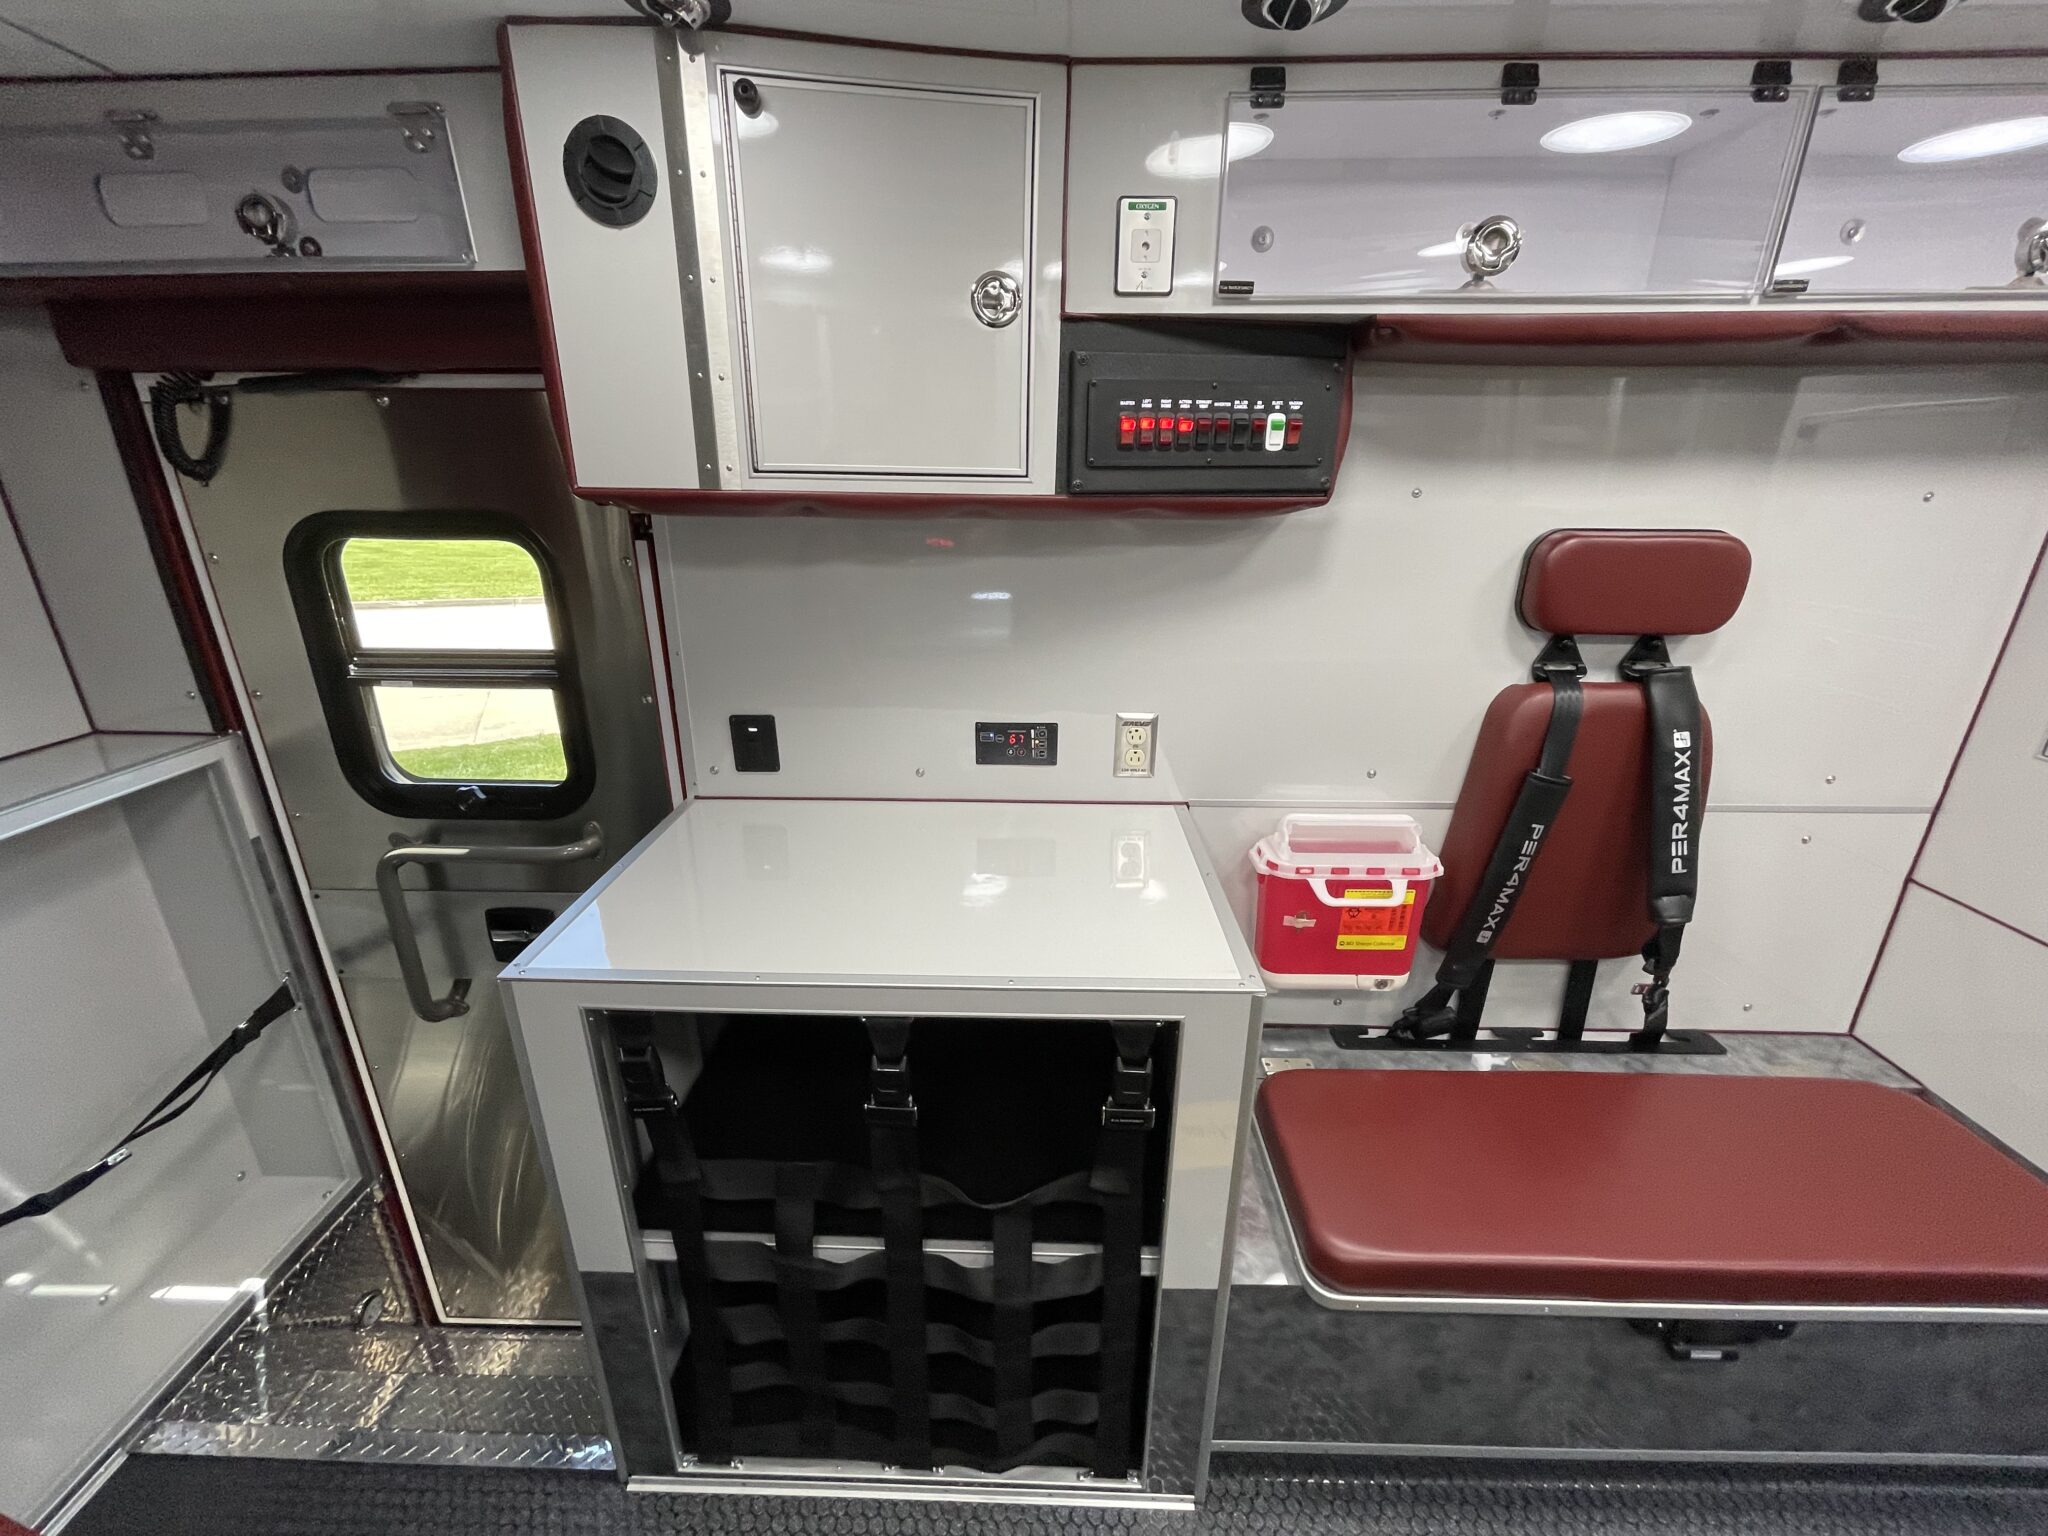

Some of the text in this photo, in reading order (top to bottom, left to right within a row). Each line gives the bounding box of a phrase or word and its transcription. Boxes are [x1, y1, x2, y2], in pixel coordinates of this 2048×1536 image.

[1135, 202, 1160, 210] OXYGEN
[1671, 750, 1691, 874] PER4MAX
[1483, 824, 1545, 929] PER4MAX
